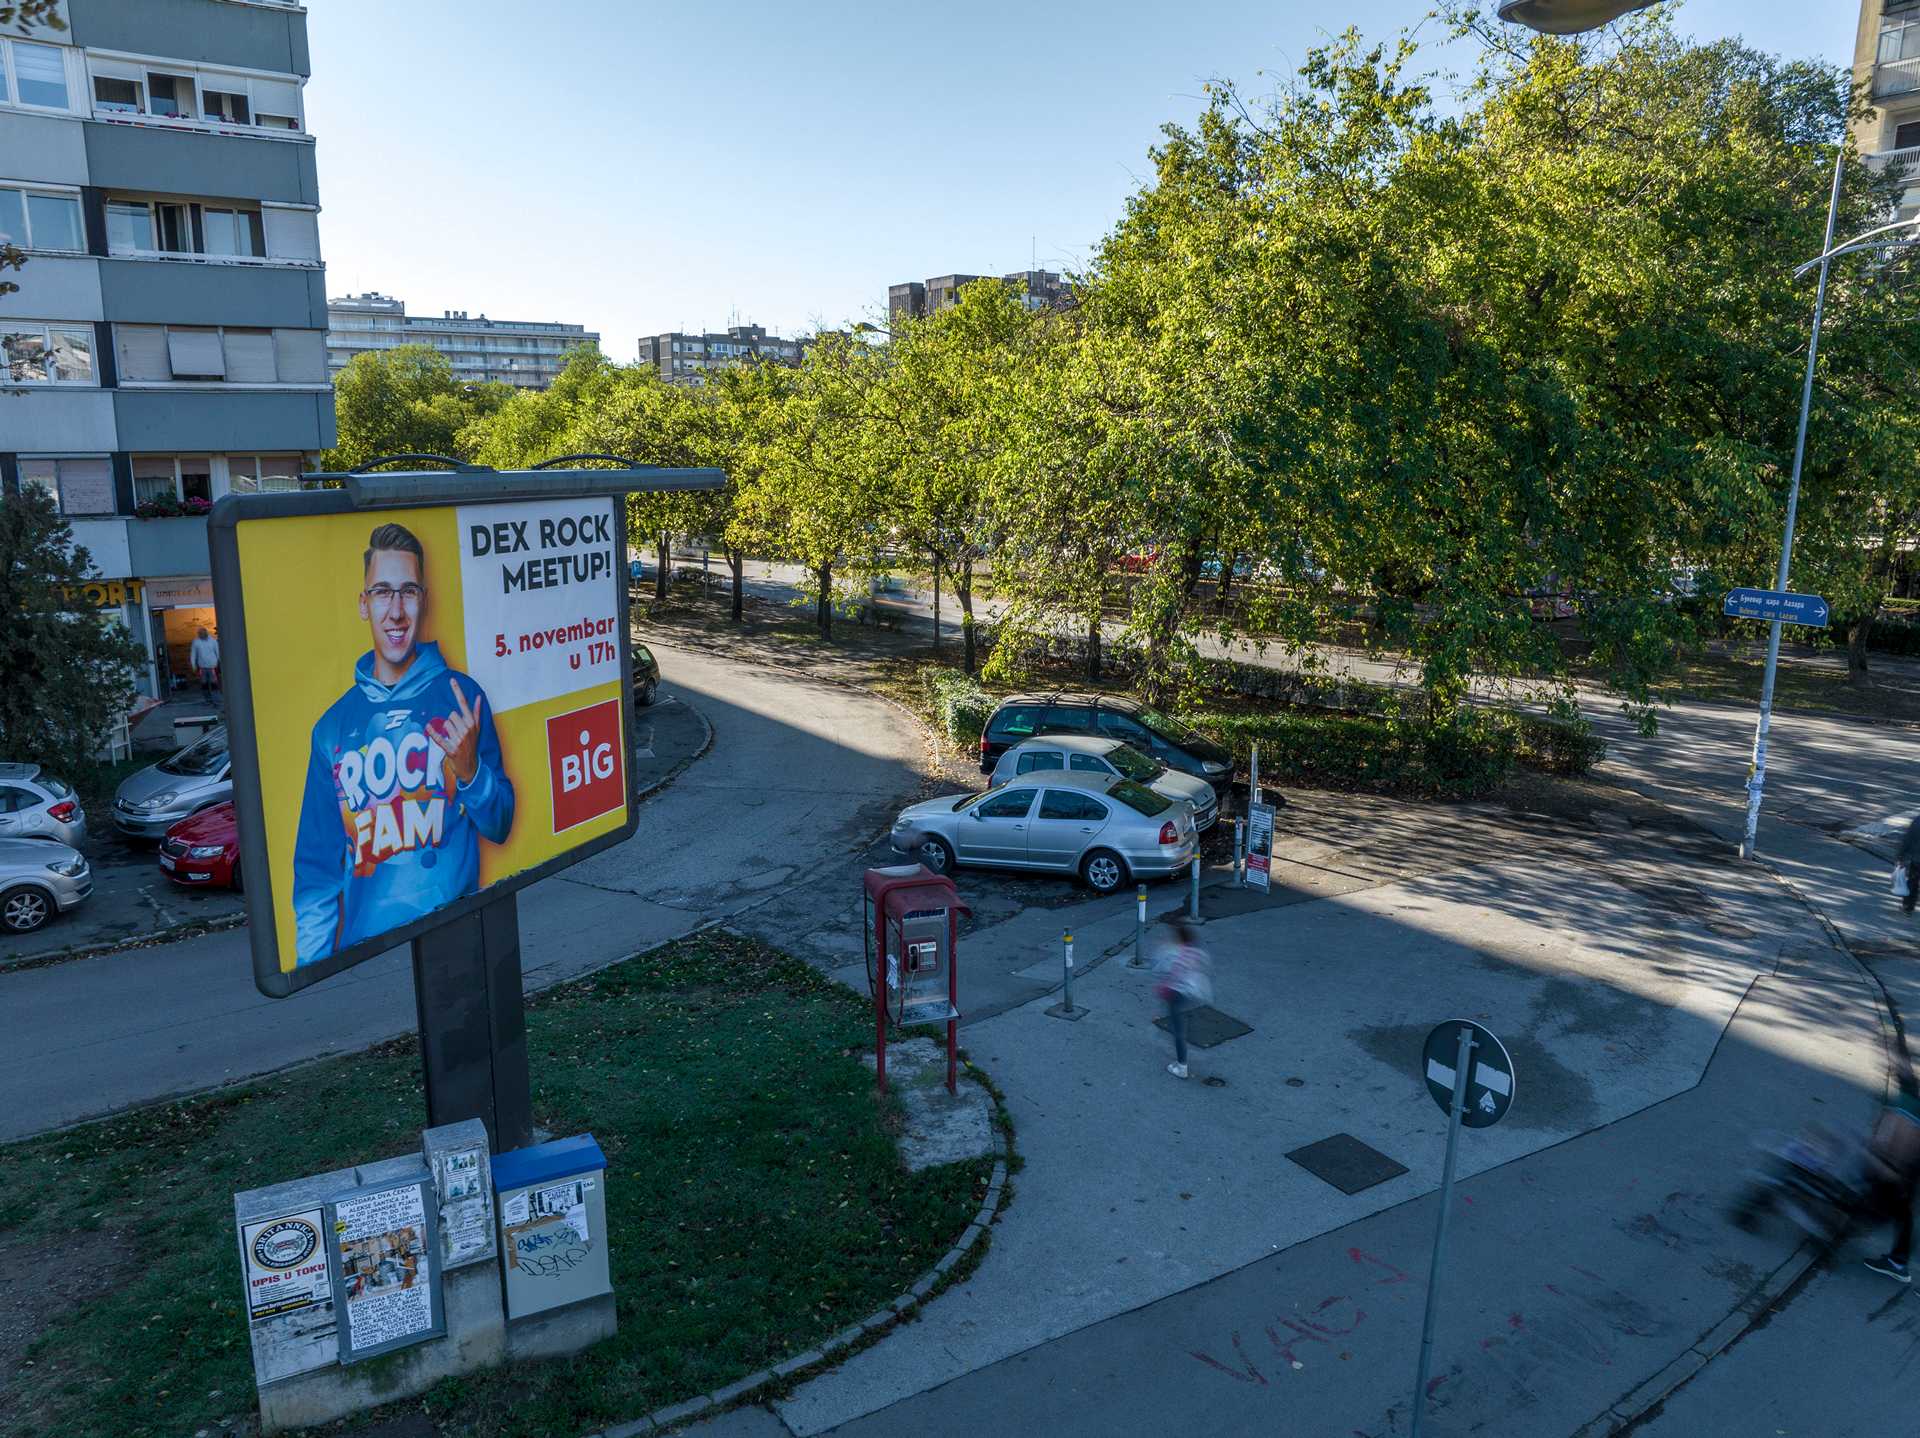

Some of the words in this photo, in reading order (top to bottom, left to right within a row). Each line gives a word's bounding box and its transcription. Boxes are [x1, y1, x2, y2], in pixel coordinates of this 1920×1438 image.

[471, 521, 530, 557] DEX
[540, 514, 611, 549] ROCK
[502, 551, 611, 594] MEETUP!
[495, 634, 512, 658] 5.
[520, 617, 615, 652] novembar
[570, 652, 581, 670] u
[588, 642, 615, 666] 17h
[338, 732, 447, 811] ROCK
[354, 798, 445, 865] FAM
[255, 1221, 316, 1251] BRITANNICA
[252, 1275, 280, 1287] UPIS
[284, 1272, 292, 1280] U
[296, 1263, 326, 1277] TOKU
